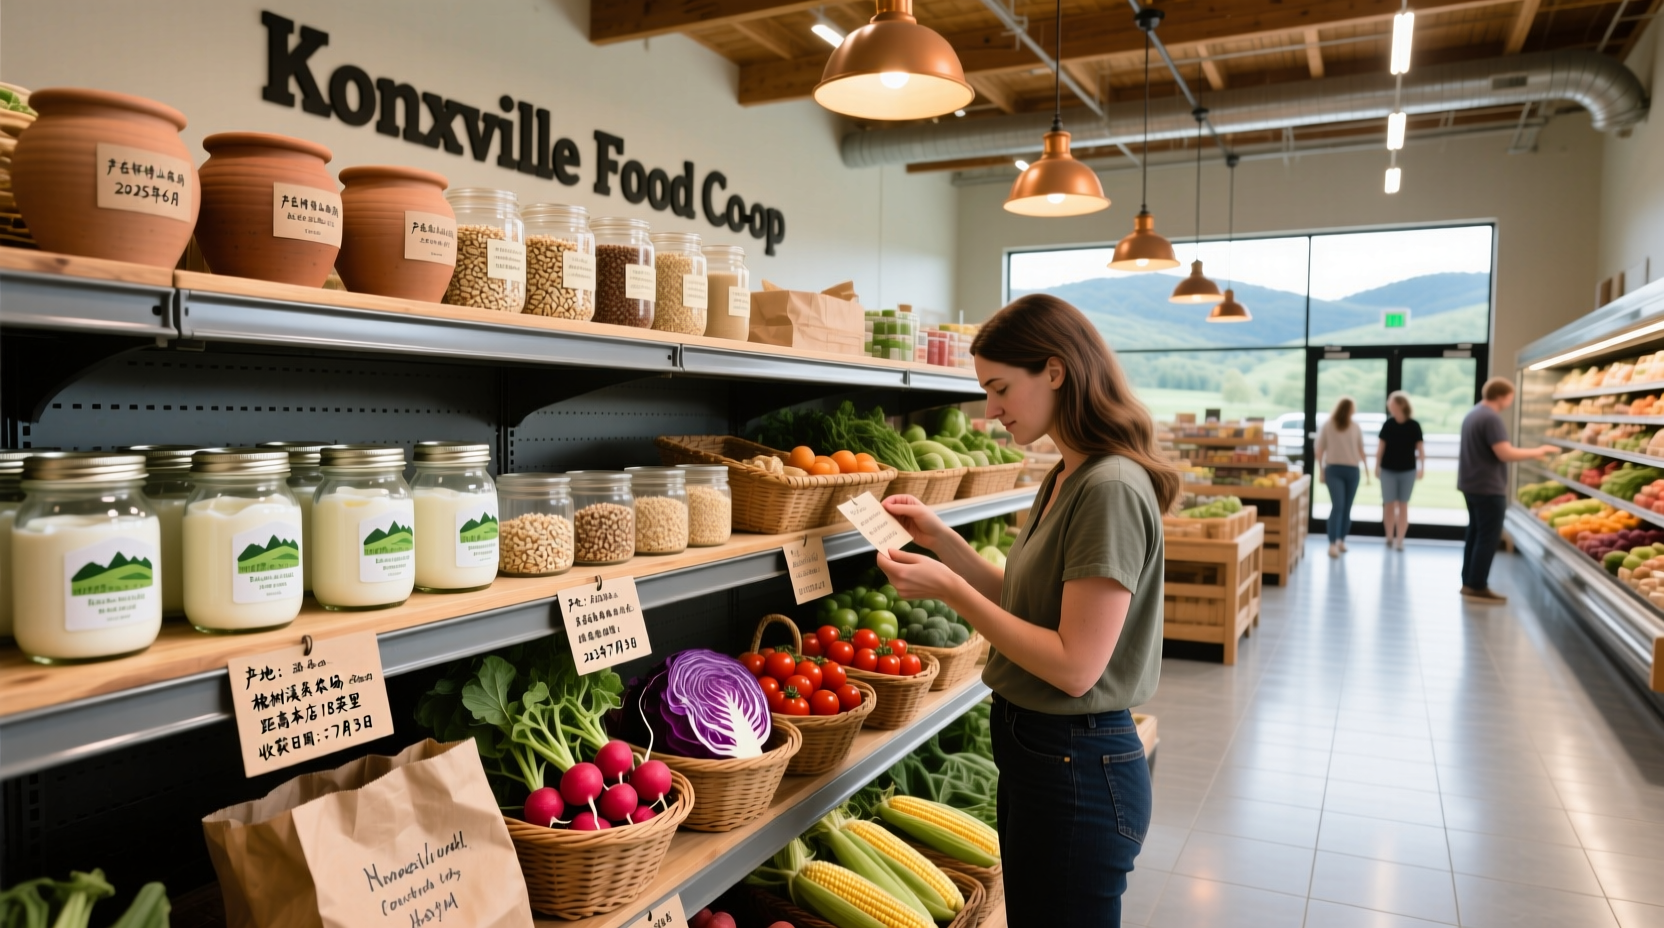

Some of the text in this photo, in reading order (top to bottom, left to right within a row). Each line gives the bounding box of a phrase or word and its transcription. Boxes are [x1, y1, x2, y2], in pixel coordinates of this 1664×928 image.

[114, 181, 179, 207] 2025年6月
[261, 10, 787, 257] Konxville Food Co-op
